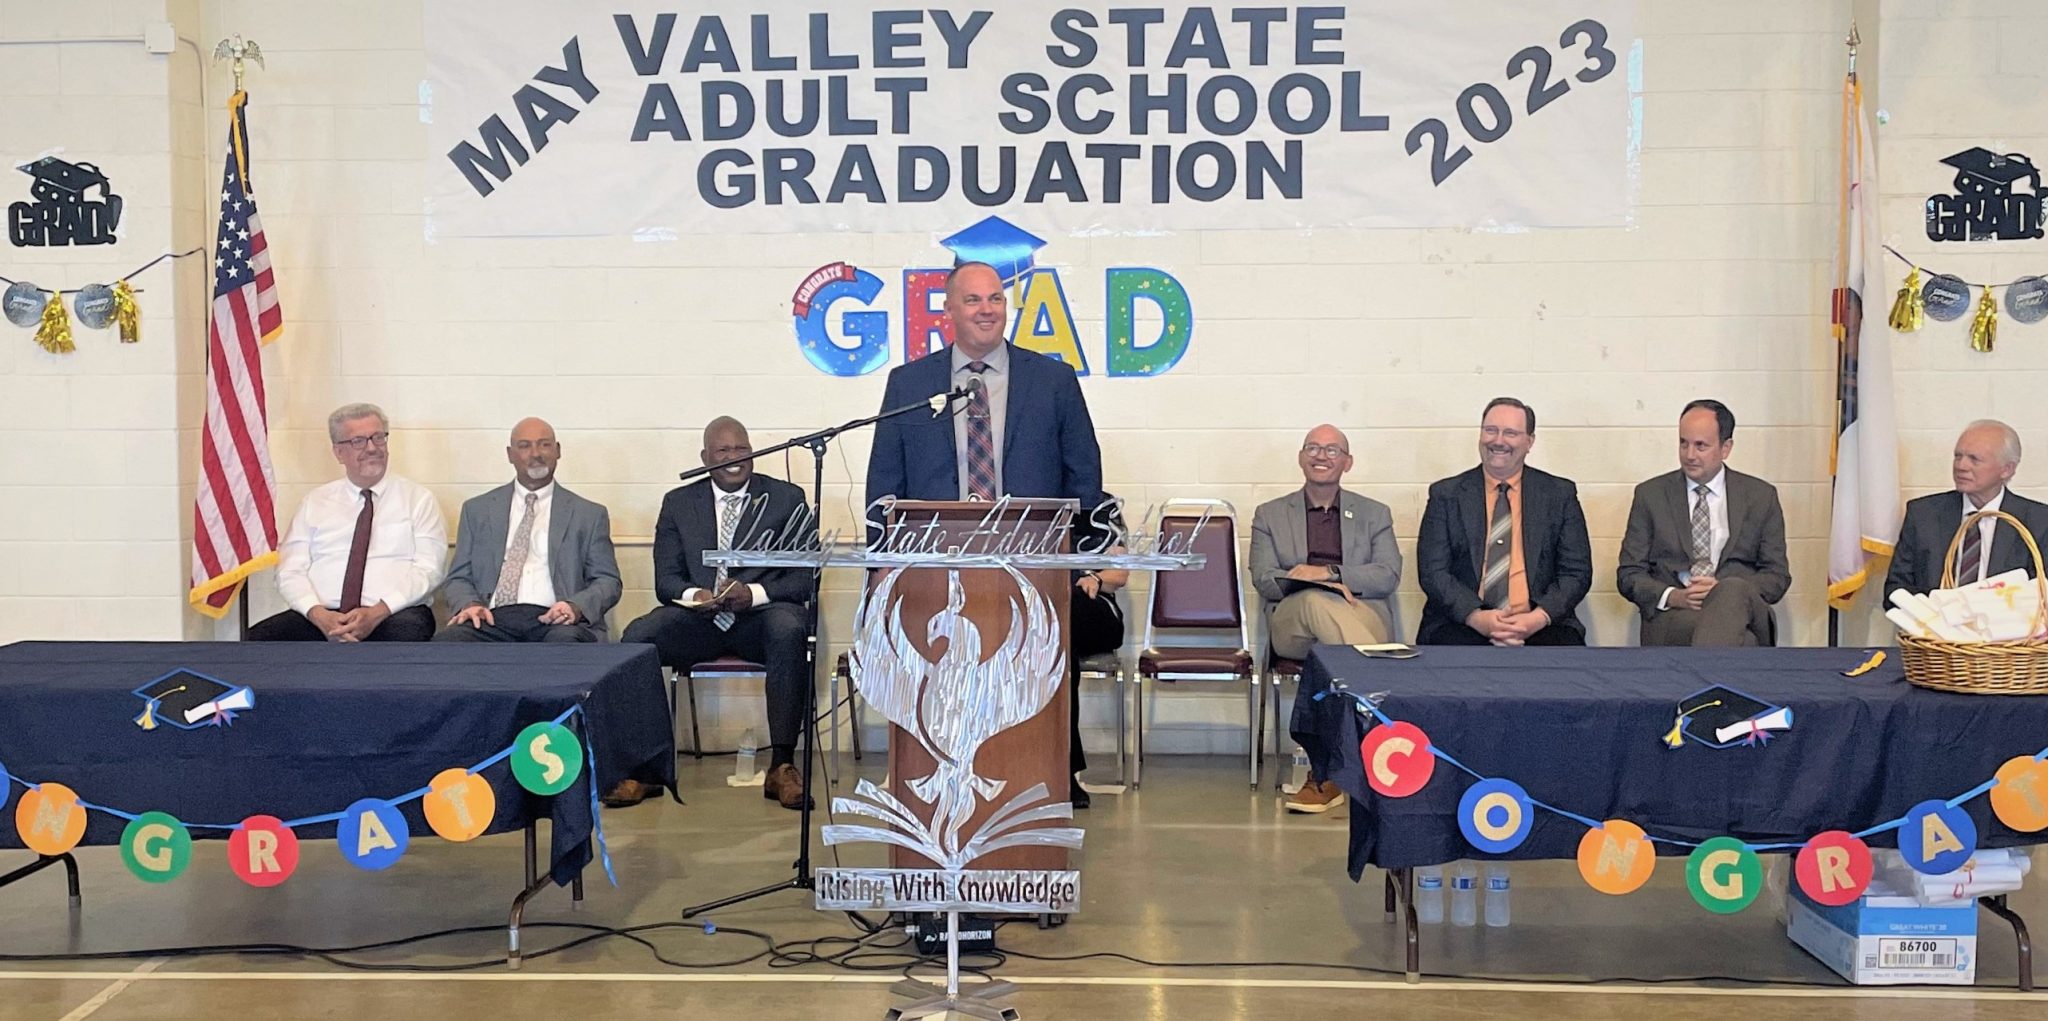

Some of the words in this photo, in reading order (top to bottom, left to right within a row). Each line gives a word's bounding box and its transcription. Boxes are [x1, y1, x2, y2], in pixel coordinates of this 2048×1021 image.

[613, 9, 993, 75] VALLEY
[1046, 6, 1345, 68] STATE
[446, 35, 600, 198] MAY
[630, 76, 928, 141] ADULT
[998, 71, 1390, 135] SCHOOL
[1404, 19, 1617, 187] 2023
[697, 139, 1303, 209] GRADUATION
[8, 194, 122, 247] GRAD!
[797, 264, 843, 303] CONGRATS
[730, 492, 842, 579] Valley
[852, 494, 947, 557] State
[959, 493, 1074, 556] Adult
[1077, 497, 1213, 557] School
[821, 872, 885, 908] Rising
[892, 872, 946, 901] With
[955, 873, 1075, 910] Knowledge
[1900, 941, 1937, 952] 86700
